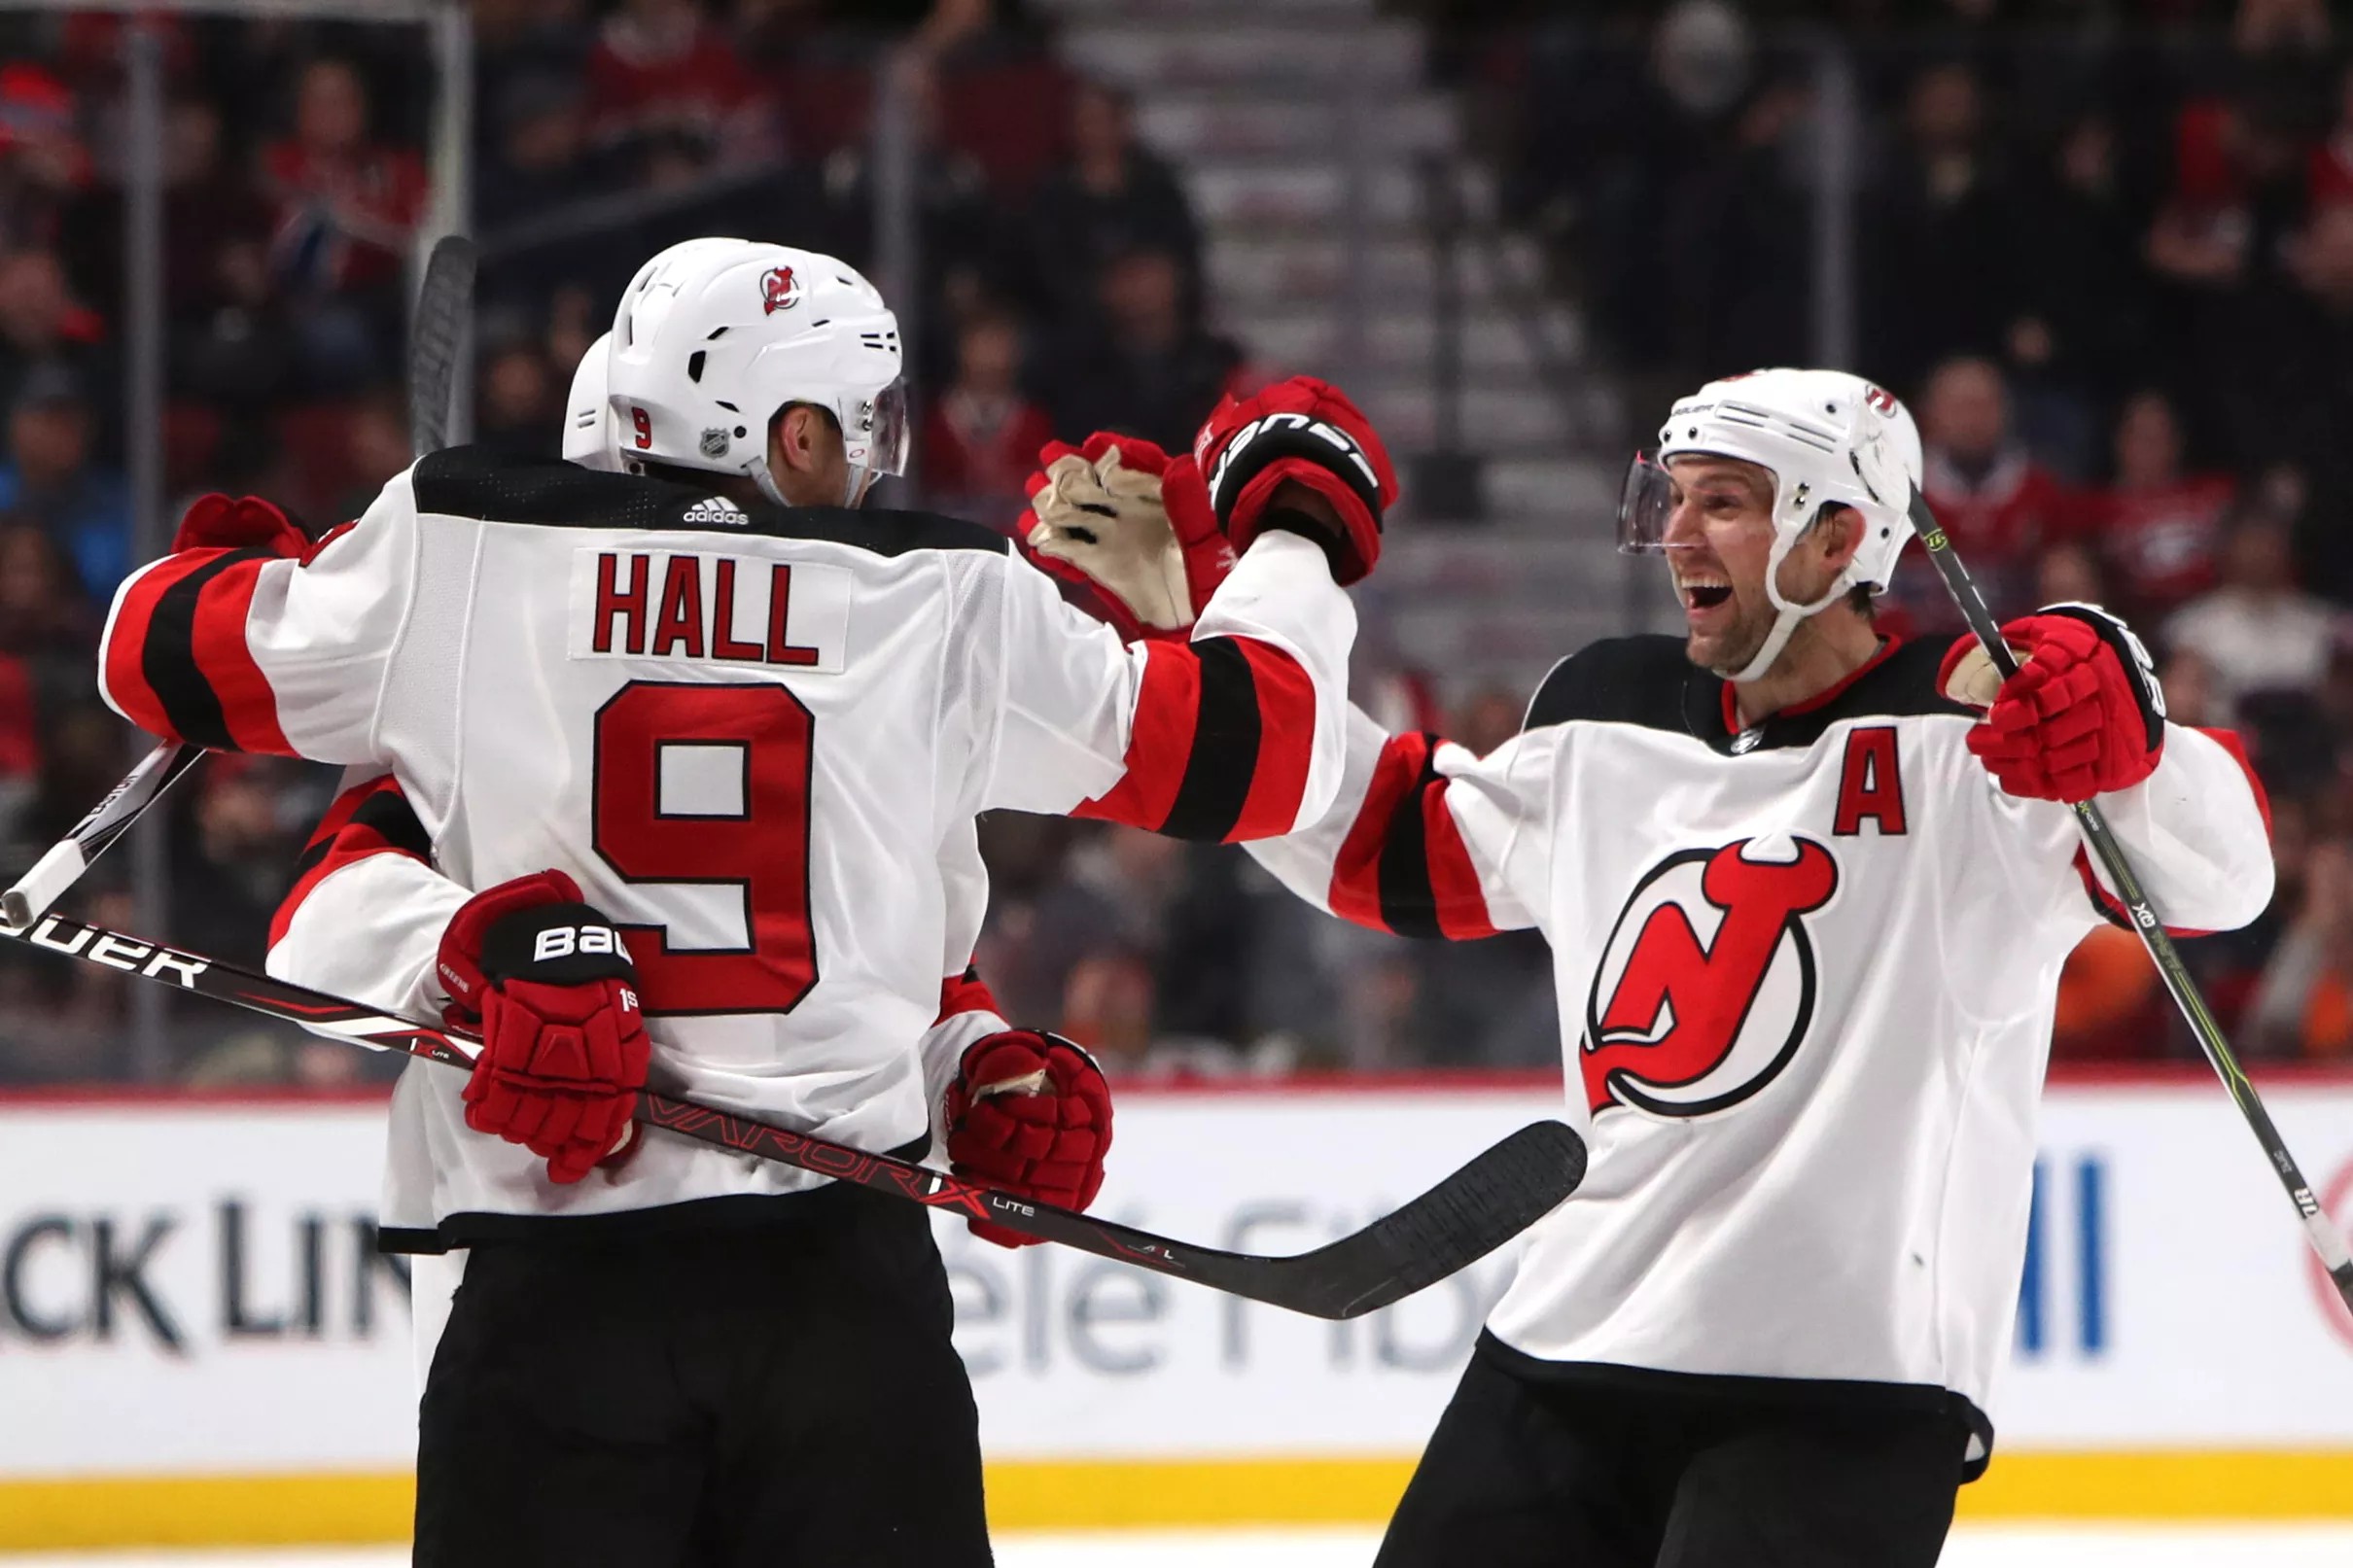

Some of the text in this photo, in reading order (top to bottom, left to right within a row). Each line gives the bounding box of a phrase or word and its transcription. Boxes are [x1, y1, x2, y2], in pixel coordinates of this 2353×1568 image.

[631, 406, 651, 449] 9
[683, 510, 749, 526] adidas
[592, 553, 820, 667] HALL
[1833, 726, 1908, 836] A
[592, 679, 820, 1019] 9
[992, 1196, 1036, 1217] LITE
[0, 1205, 191, 1357] CK
